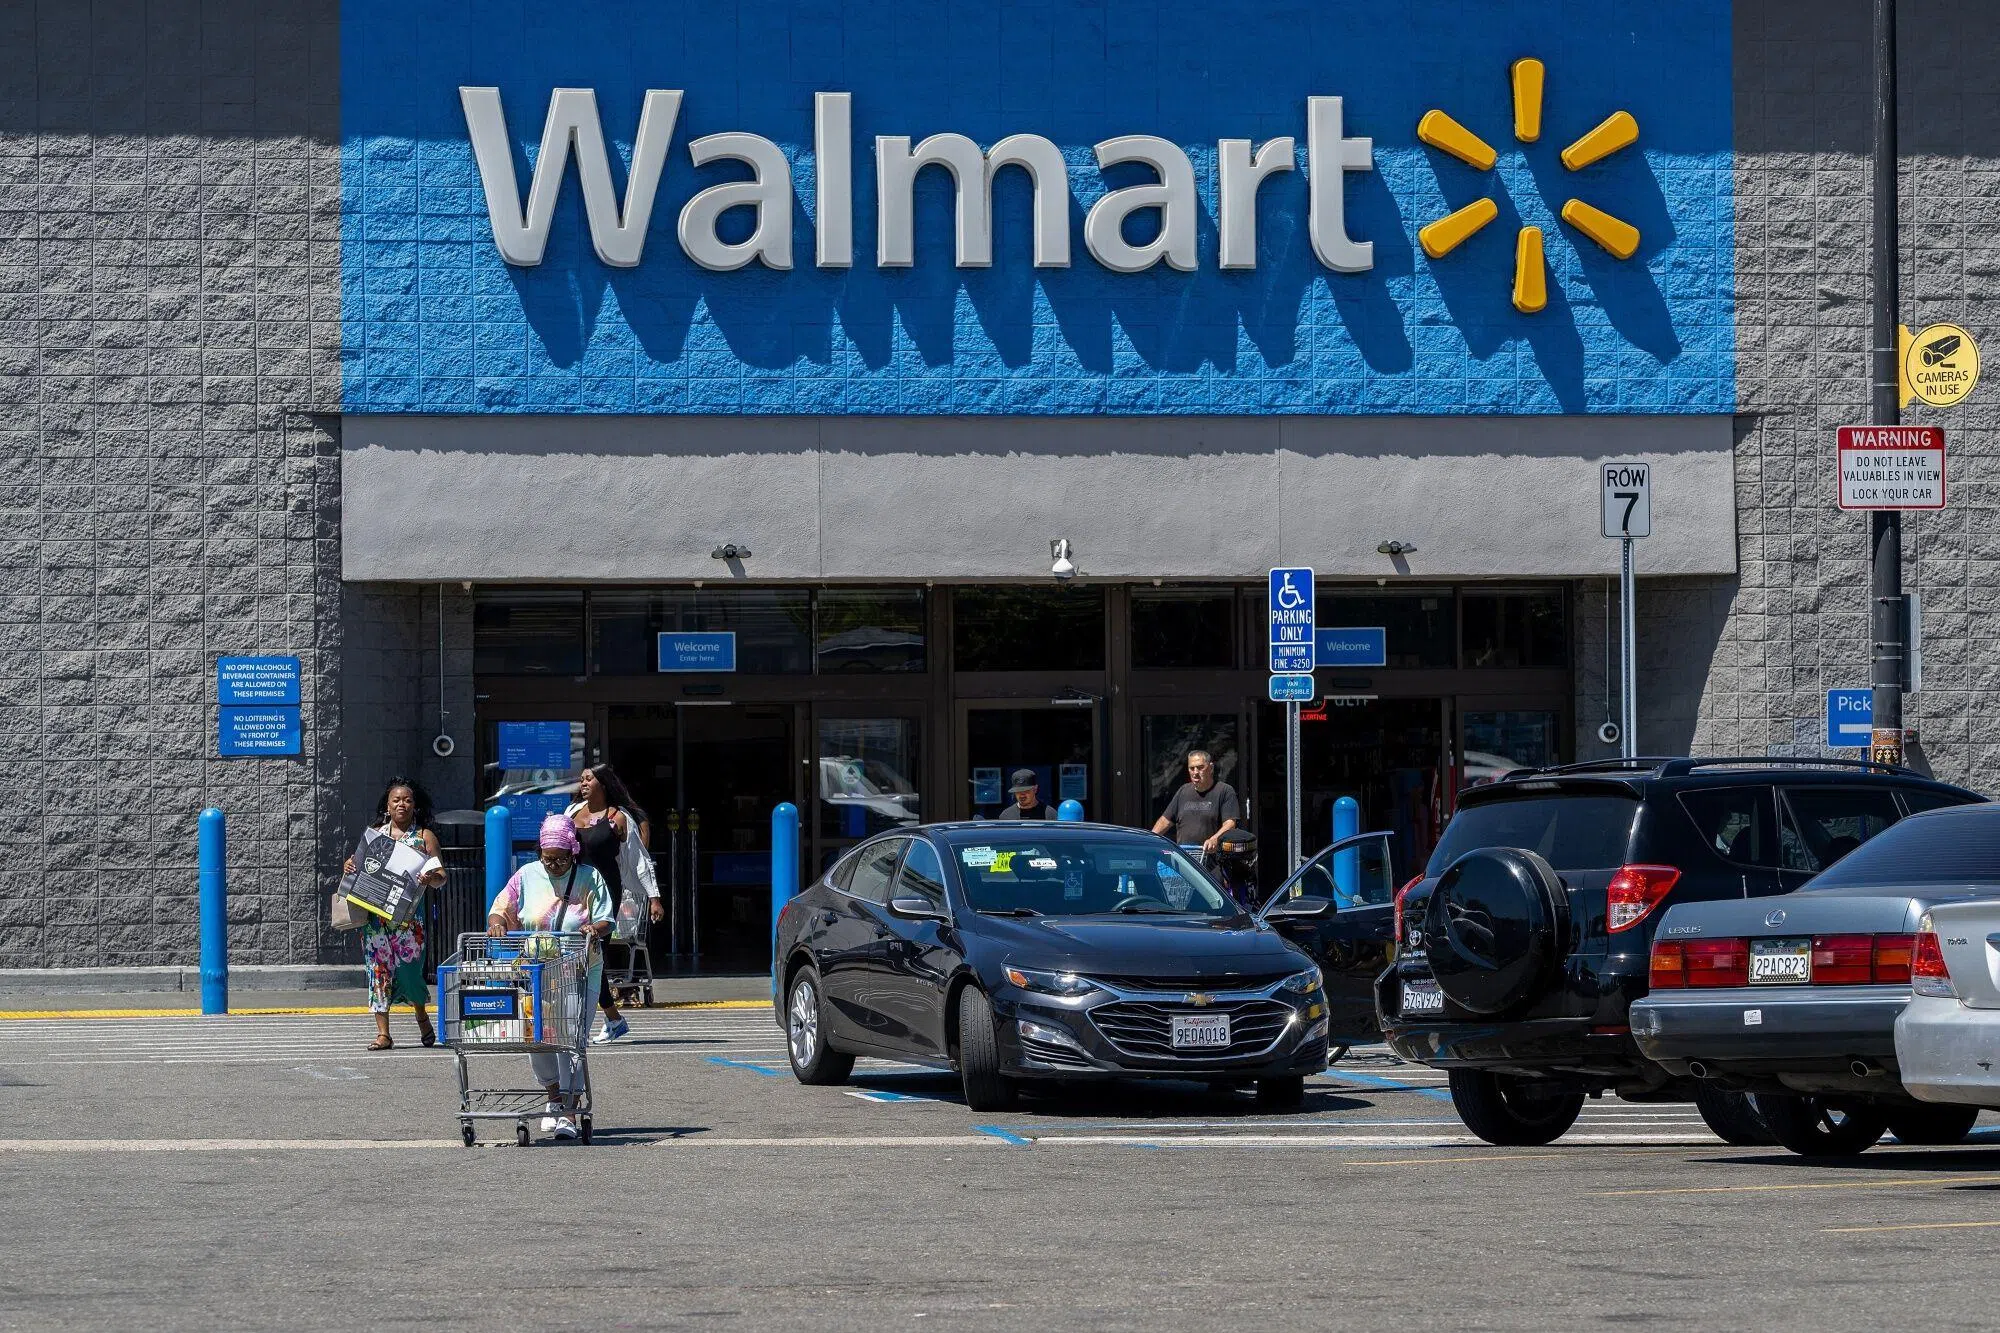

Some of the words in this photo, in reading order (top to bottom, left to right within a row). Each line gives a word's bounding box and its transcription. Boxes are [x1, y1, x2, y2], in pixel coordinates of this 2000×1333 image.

[459, 85, 1374, 273] Walmart
[1916, 370, 1969, 384] CAMERAS
[1926, 385, 1937, 396] IN
[1939, 384, 1960, 395] USE
[1851, 431, 1932, 447] WARNING
[1856, 456, 1870, 467] DO
[1874, 456, 1892, 467] NOT
[1896, 456, 1927, 467] LEAVE
[1606, 469, 1645, 487] ROW
[1843, 470, 1900, 481] VALUABLES
[1904, 470, 1914, 481] IN
[1917, 470, 1940, 481] VIEW
[1852, 488, 1878, 499] LOCK
[1882, 488, 1909, 500] YOUR
[1912, 488, 1932, 499] CAR
[1614, 492, 1639, 531] 7
[1272, 609, 1312, 624] PARKING
[1280, 626, 1303, 641] ONLY
[674, 642, 720, 652] Welcome
[1278, 647, 1306, 657] MINIMUM
[1326, 641, 1371, 651] Welcome
[1274, 659, 1288, 669] FINE
[233, 690, 253, 698] THESE
[1668, 925, 1701, 934] LEXUS
[1755, 957, 1806, 976] 2PAC823
